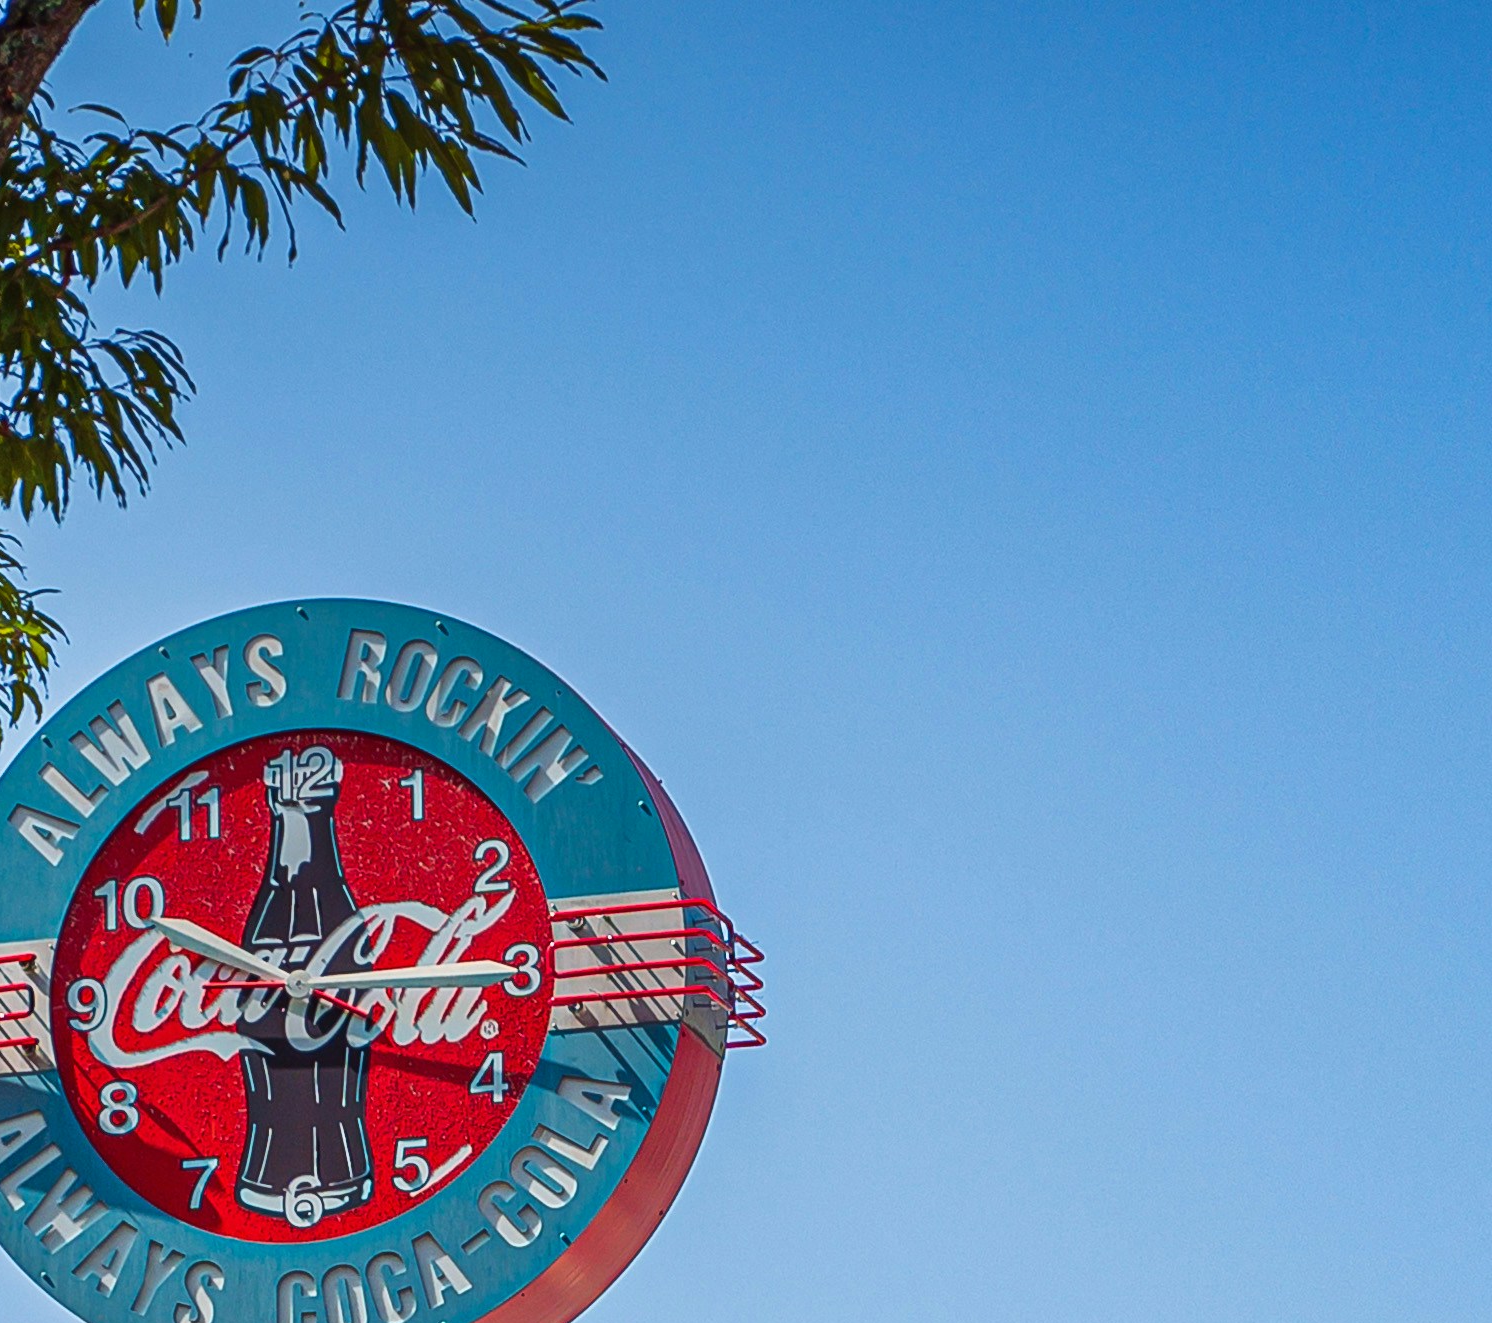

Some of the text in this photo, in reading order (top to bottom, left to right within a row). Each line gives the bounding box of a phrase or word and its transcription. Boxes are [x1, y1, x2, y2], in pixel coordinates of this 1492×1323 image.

[8, 628, 604, 866] ALWAYS ROCKIN'
[268, 745, 336, 801] 12
[166, 784, 221, 842] 11
[399, 767, 425, 821] 1
[472, 838, 512, 894] 2
[93, 874, 166, 932] 10
[88, 888, 516, 1068] Coca-Cola
[502, 942, 544, 998] 3
[65, 977, 108, 1033] 9
[469, 1051, 510, 1104] 4
[97, 1080, 141, 1136] 8
[179, 1156, 220, 1211] 7
[391, 1137, 431, 1193] 5
[284, 1174, 324, 1229] 6
